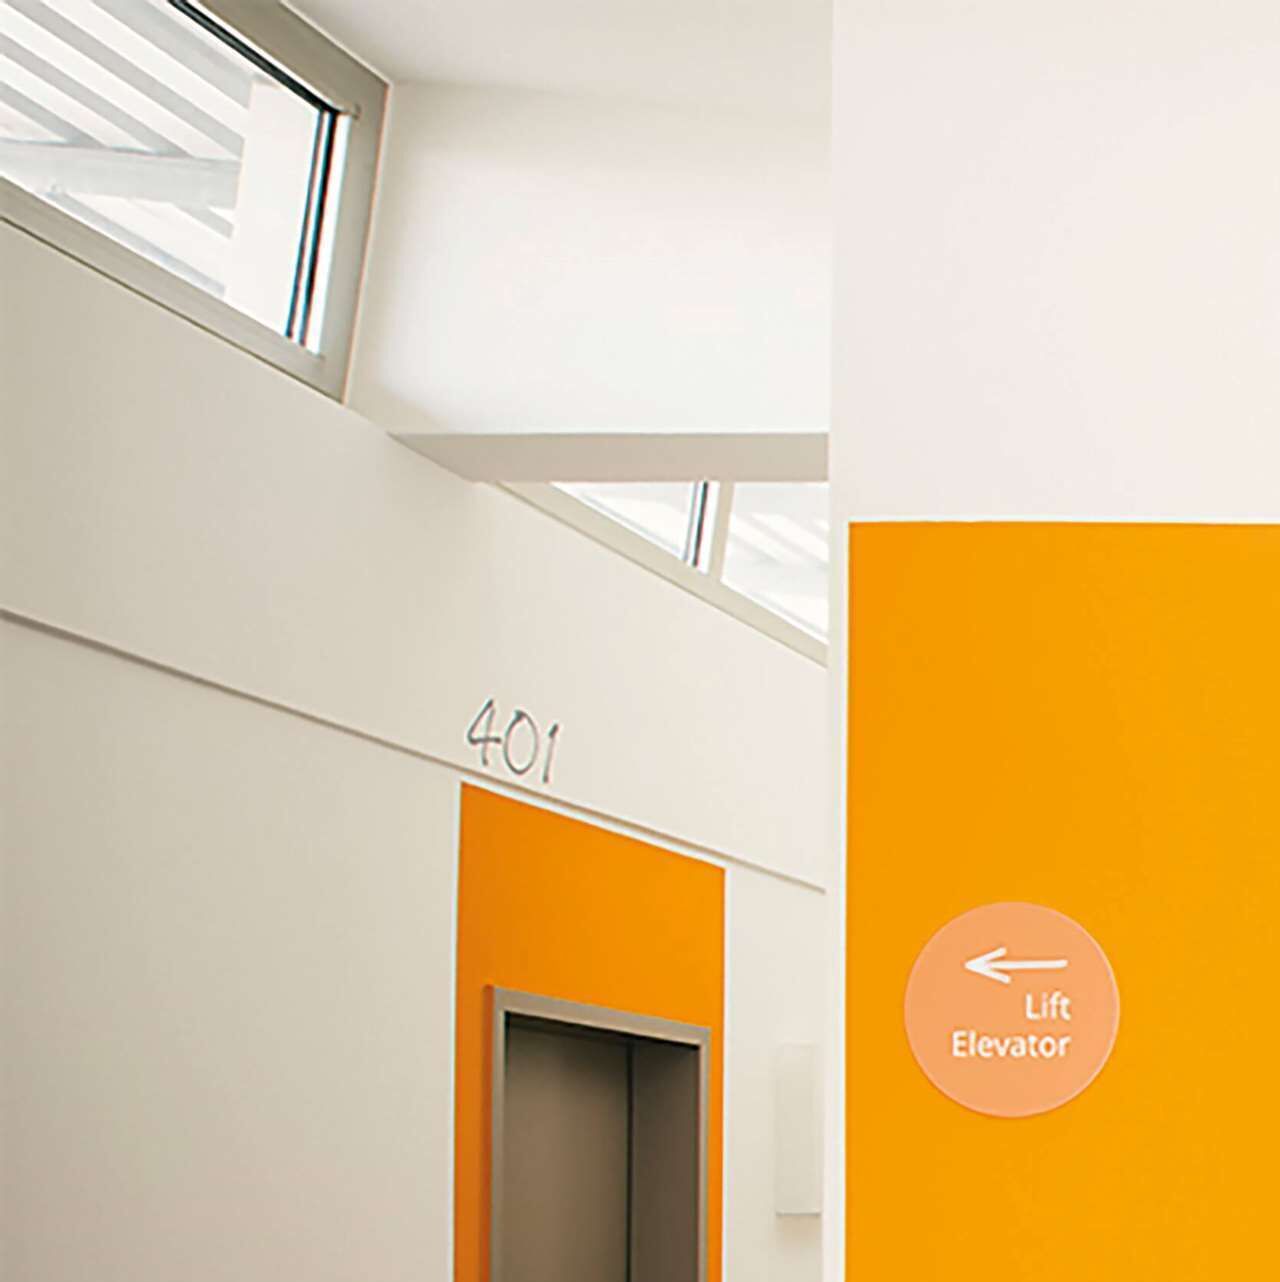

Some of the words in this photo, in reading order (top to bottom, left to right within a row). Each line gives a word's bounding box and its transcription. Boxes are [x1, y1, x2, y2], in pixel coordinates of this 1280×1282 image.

[466, 698, 560, 784] 401
[1025, 991, 1072, 1021] Lift
[951, 1029, 1072, 1058] Elevator
